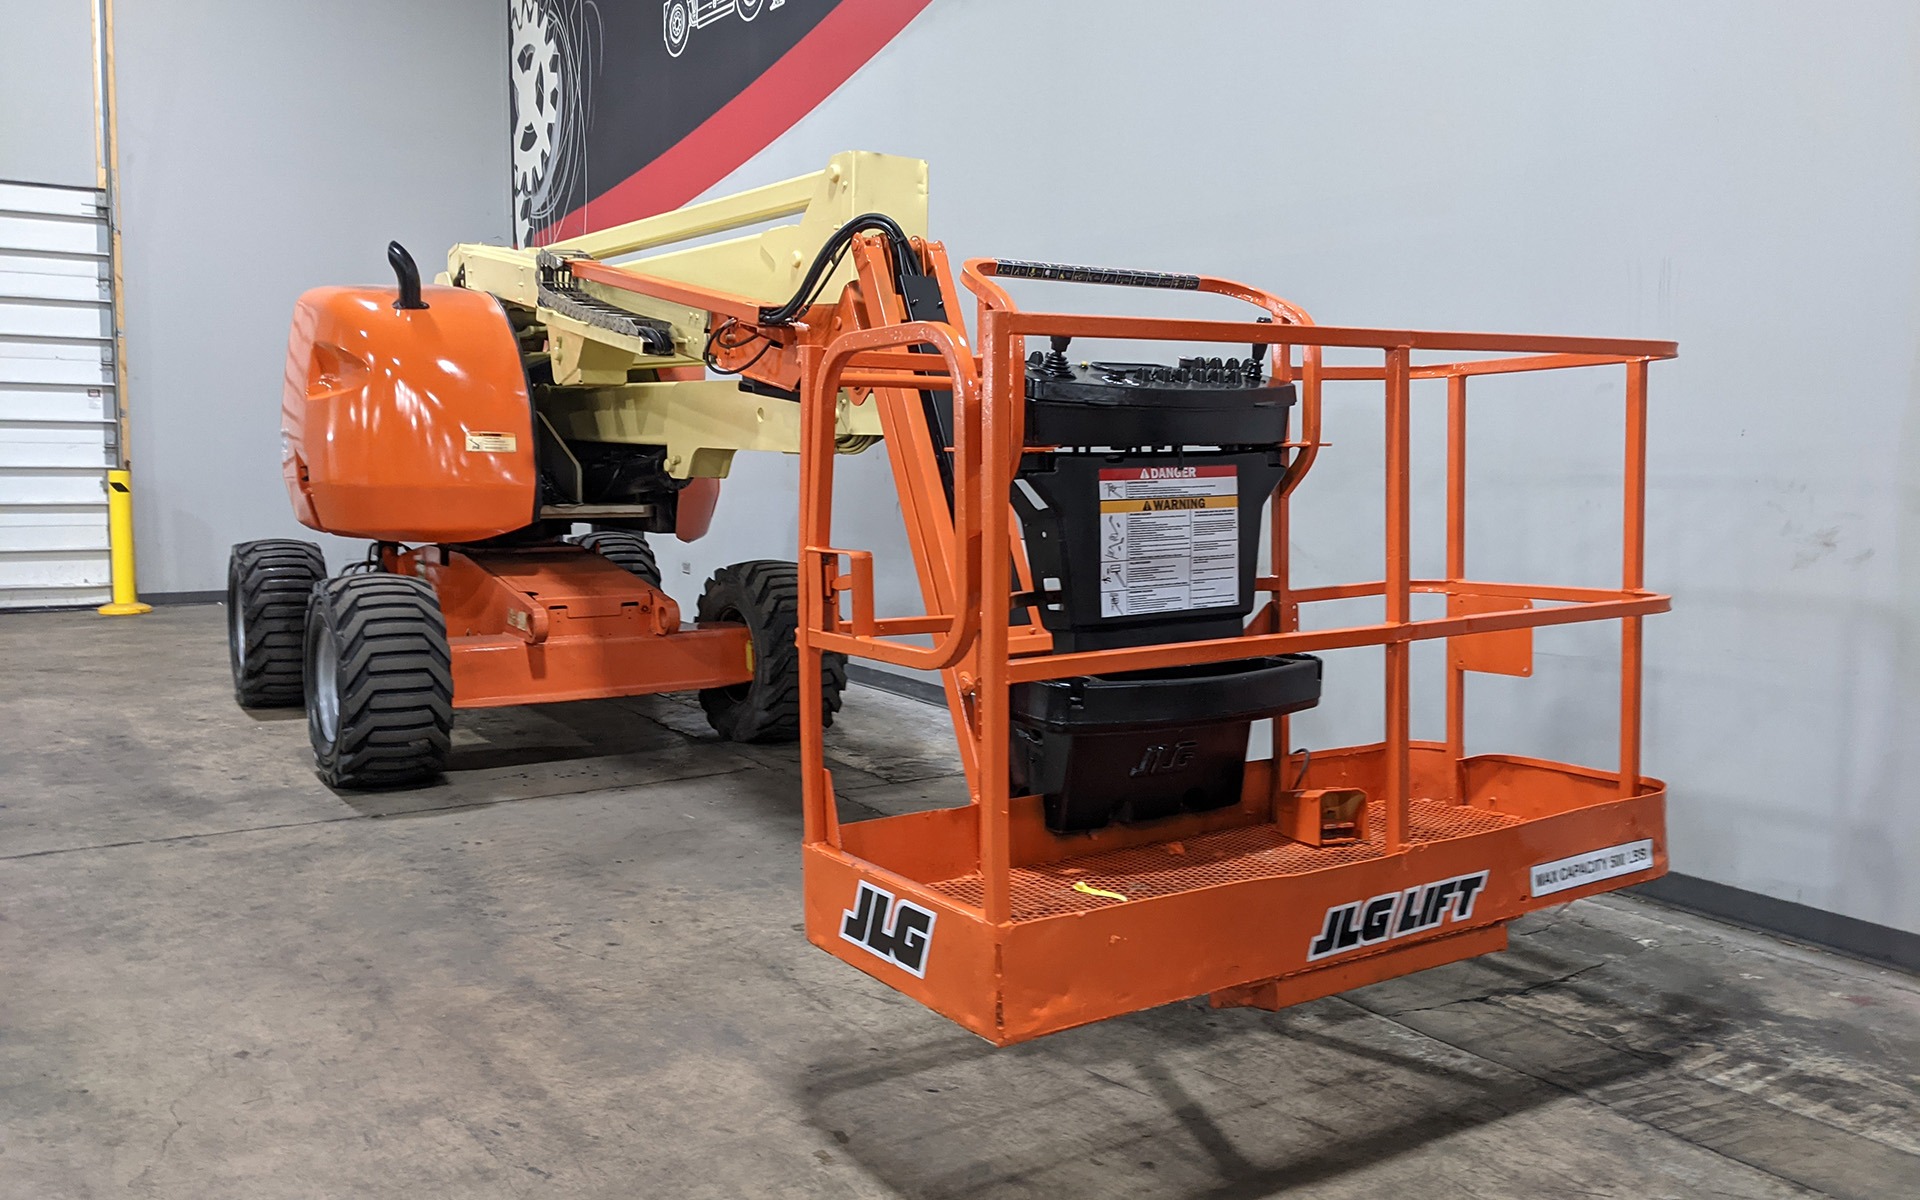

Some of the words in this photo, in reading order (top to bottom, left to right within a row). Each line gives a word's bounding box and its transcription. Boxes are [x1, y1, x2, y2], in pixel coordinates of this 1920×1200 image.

[1150, 466, 1197, 479] DANGER
[1153, 498, 1206, 511] WARNING
[841, 883, 934, 976] JLG
[1300, 895, 1398, 958] JLG
[1395, 873, 1487, 935] LIFT
